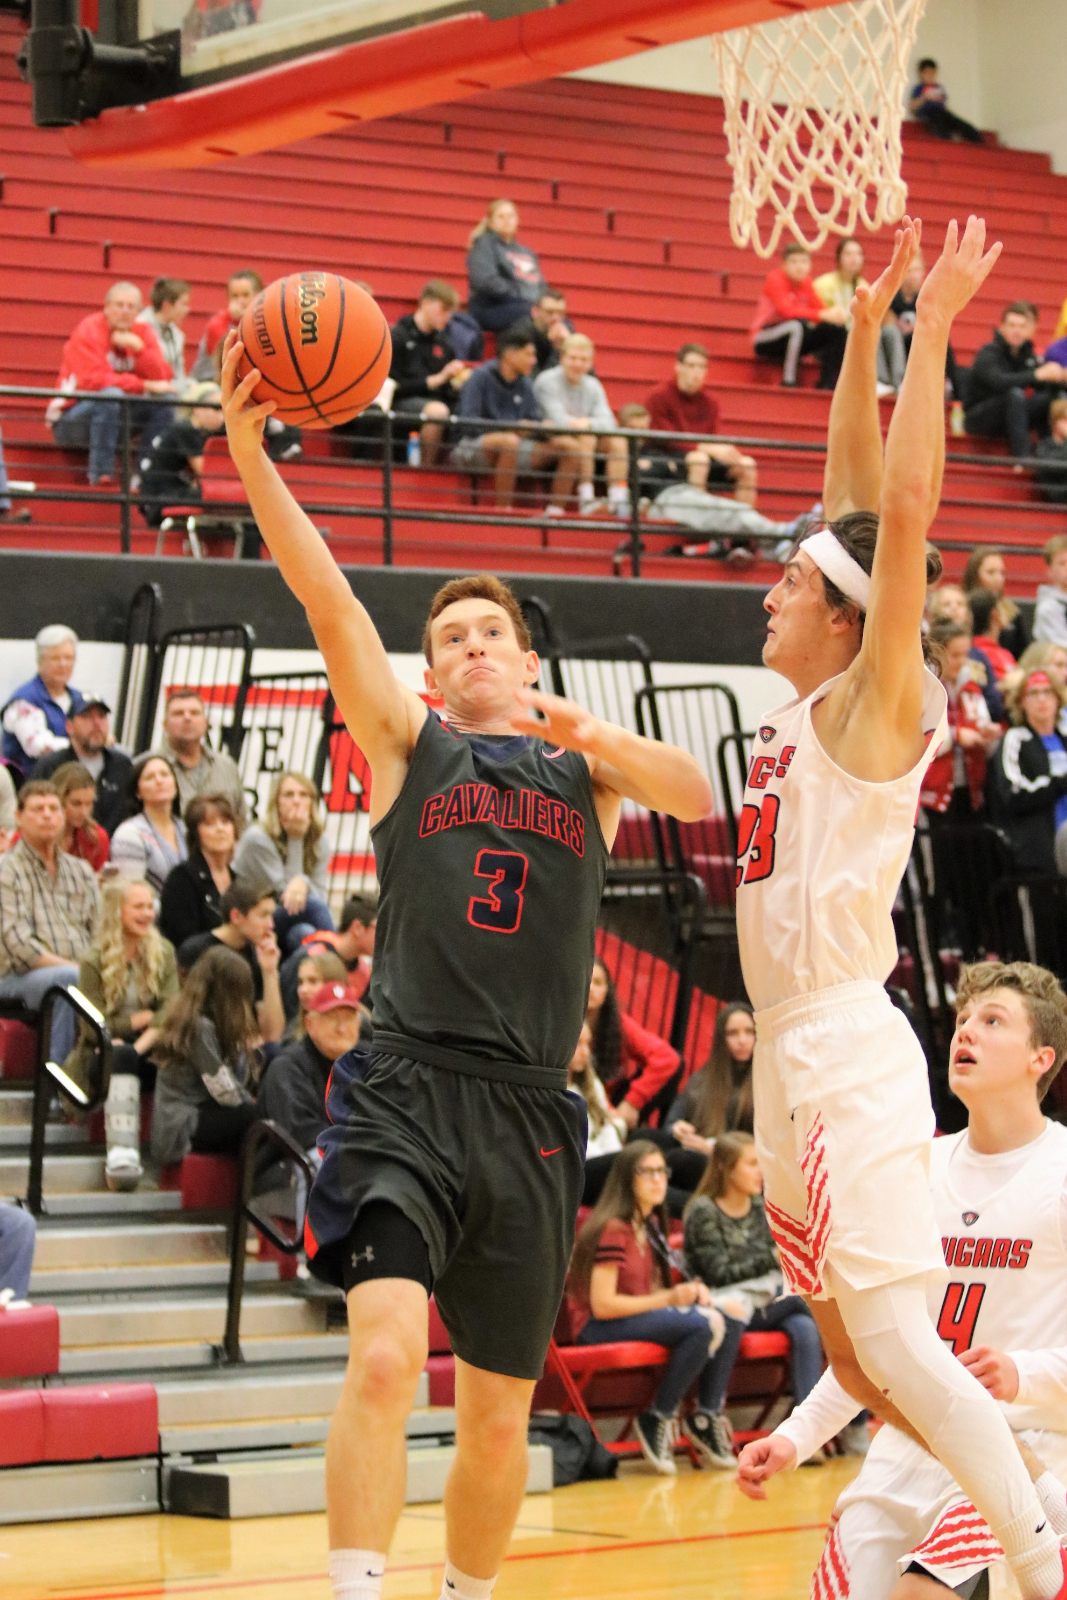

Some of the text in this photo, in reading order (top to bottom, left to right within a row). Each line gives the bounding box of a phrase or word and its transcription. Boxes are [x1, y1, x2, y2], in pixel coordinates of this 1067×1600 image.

[253, 290, 276, 356] UTION
[418, 783, 585, 858] CAVALIERS
[466, 848, 530, 934] 3
[941, 1236, 1034, 1270] UGARS
[936, 1282, 987, 1358] 4
